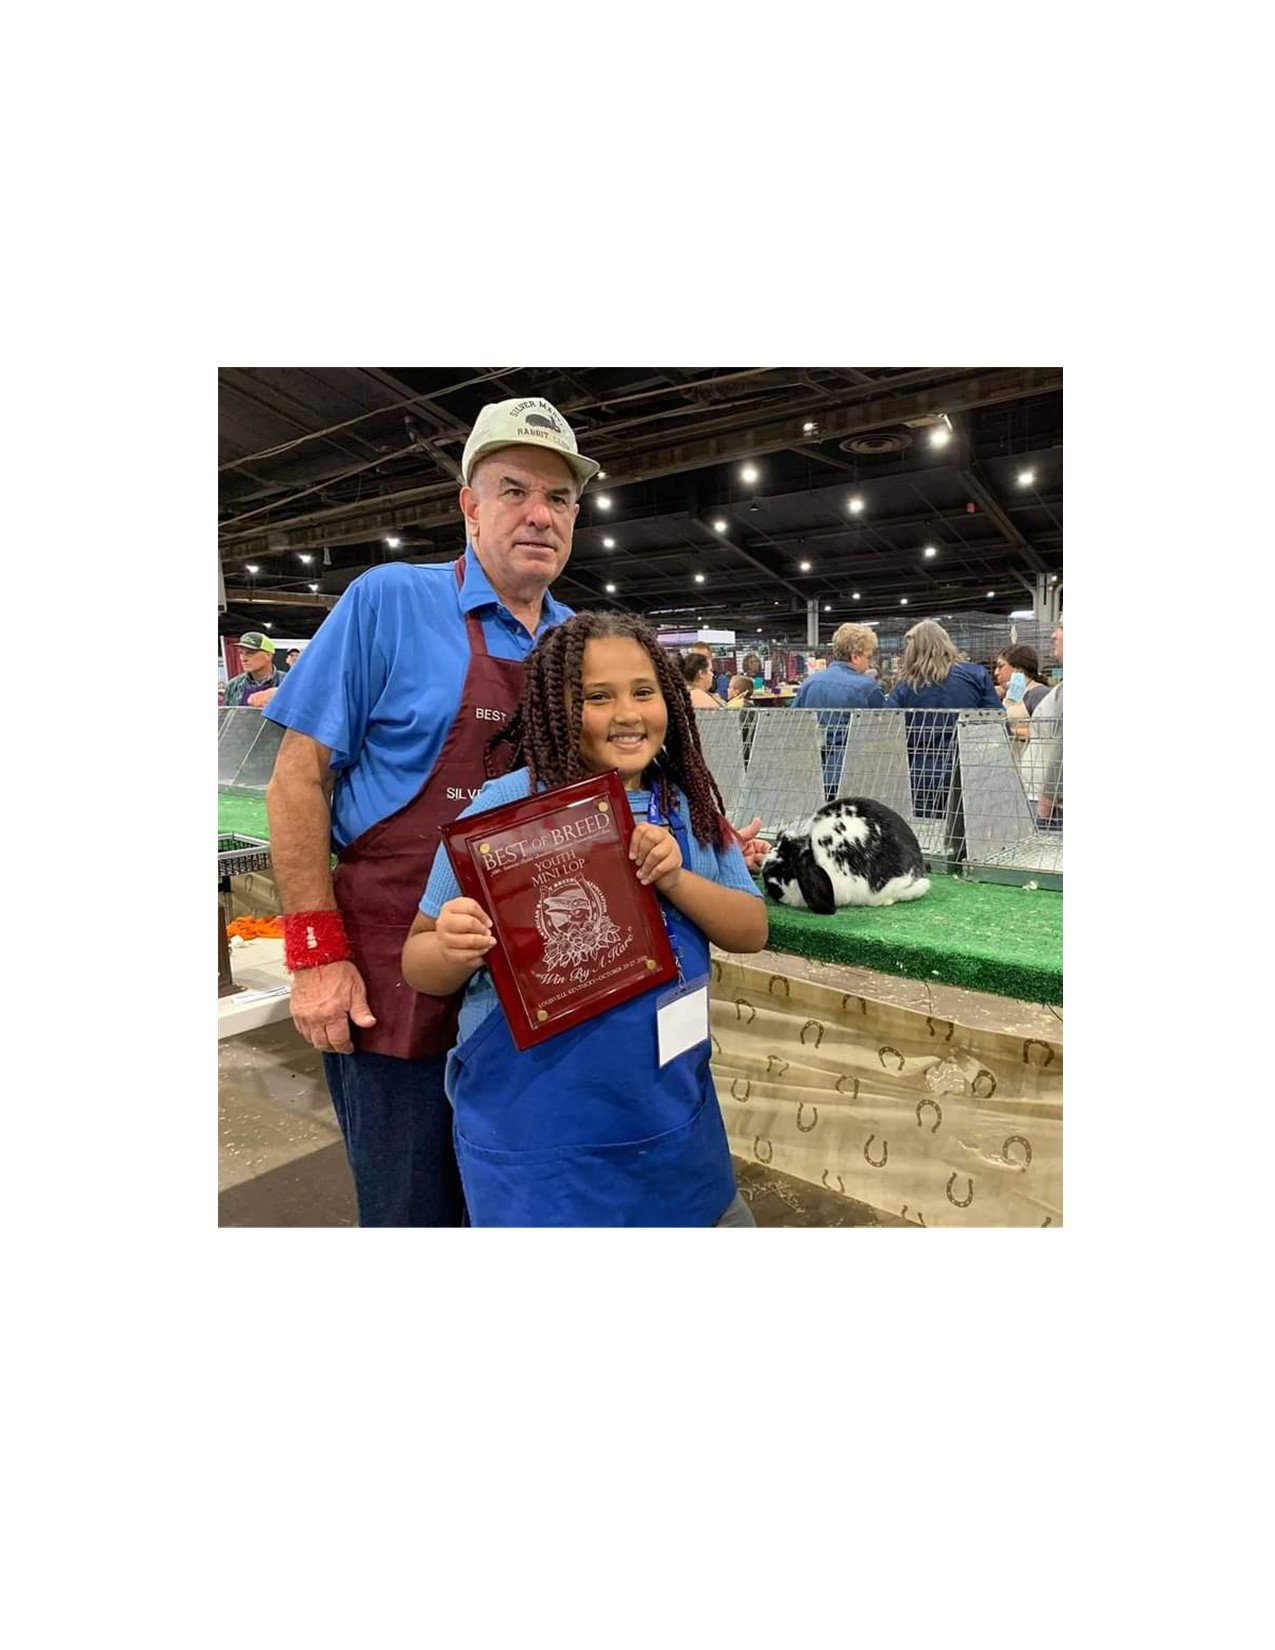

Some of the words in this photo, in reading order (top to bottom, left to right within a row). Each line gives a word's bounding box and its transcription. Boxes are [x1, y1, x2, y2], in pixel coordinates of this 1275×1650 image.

[509, 400, 537, 418] SILVER
[516, 427, 550, 440] RABBIT
[475, 707, 508, 723] BEST
[482, 838, 529, 872] BEST
[550, 812, 611, 845] BREED
[531, 865, 562, 888] MINI
[563, 857, 587, 875] LOP
[534, 849, 577, 873] YOUTH
[569, 966, 591, 985] By
[591, 958, 606, 974] A
